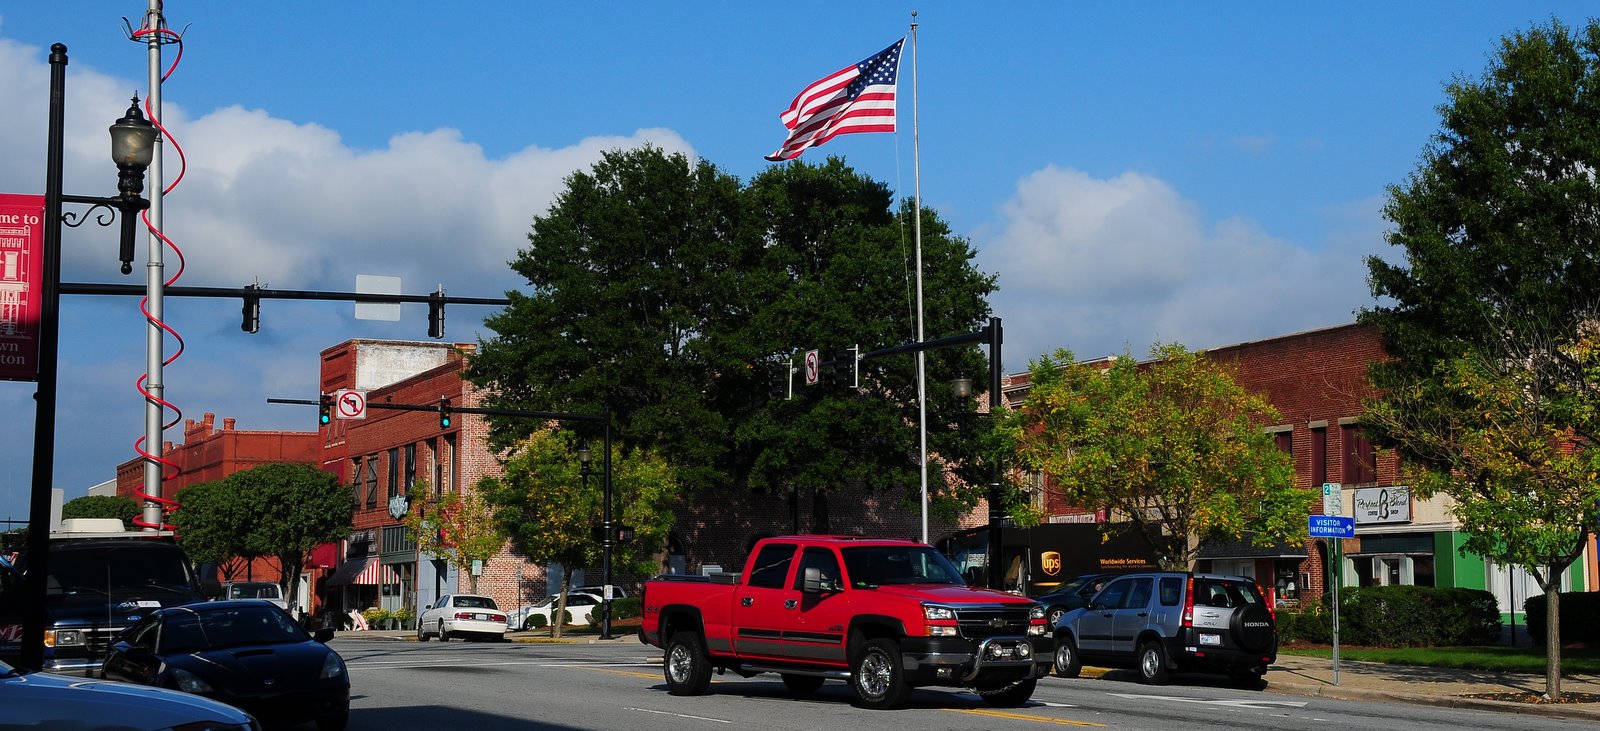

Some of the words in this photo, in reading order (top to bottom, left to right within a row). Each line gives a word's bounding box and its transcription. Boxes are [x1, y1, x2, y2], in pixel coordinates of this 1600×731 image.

[23, 213, 39, 225] to
[1324, 485, 1330, 495] 2
[1316, 519, 1341, 527] VISITOR
[1310, 526, 1346, 534] INFORMATION
[1043, 558, 1060, 573] ups
